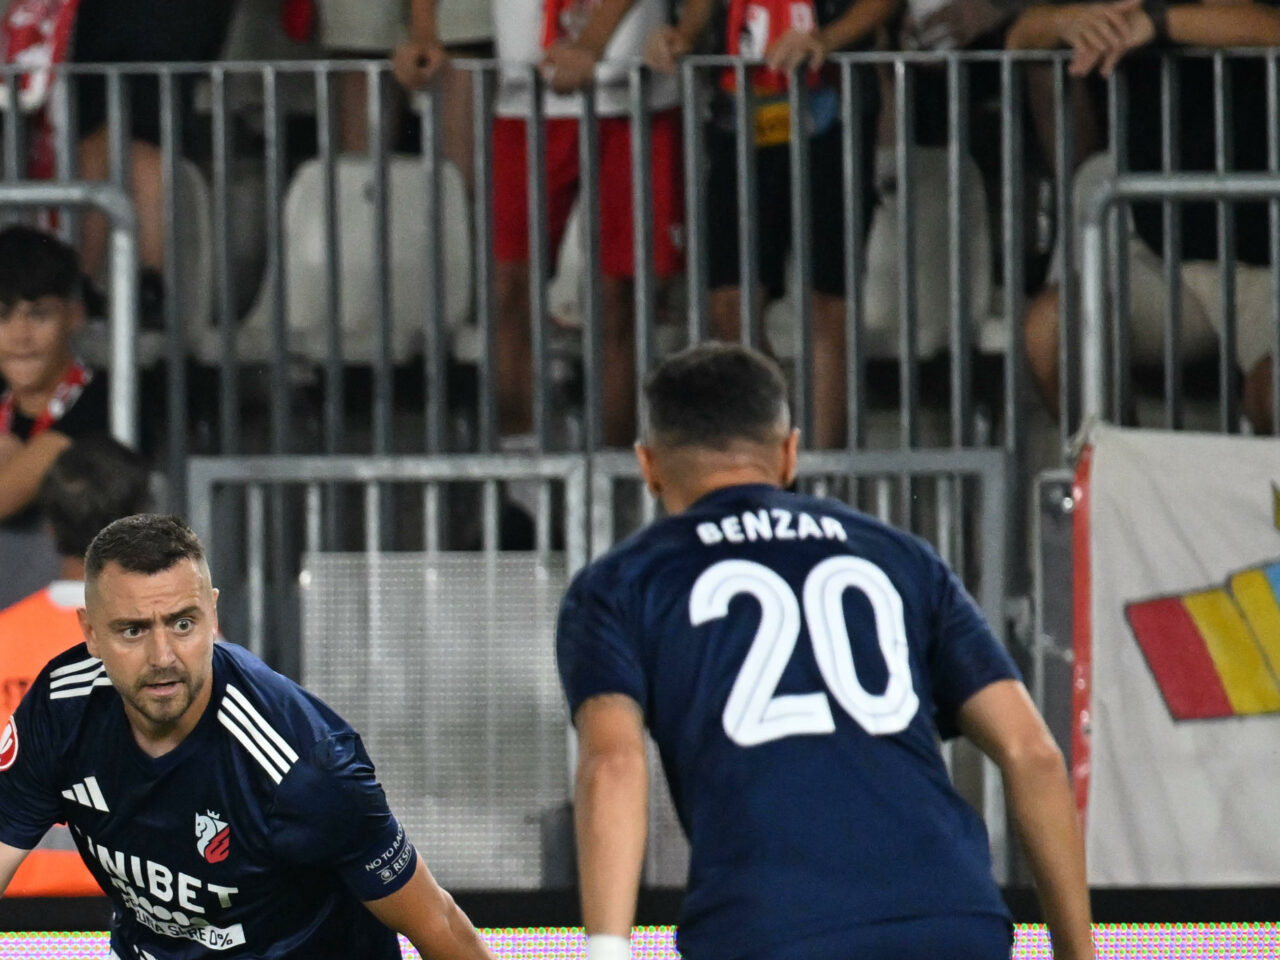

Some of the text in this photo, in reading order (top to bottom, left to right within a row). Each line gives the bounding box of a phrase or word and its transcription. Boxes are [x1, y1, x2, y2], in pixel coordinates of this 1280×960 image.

[696, 508, 848, 545] BENZAR
[689, 555, 919, 747] 20
[82, 832, 239, 914] NIBET
[365, 858, 382, 871] NO
[381, 847, 395, 861] TO
